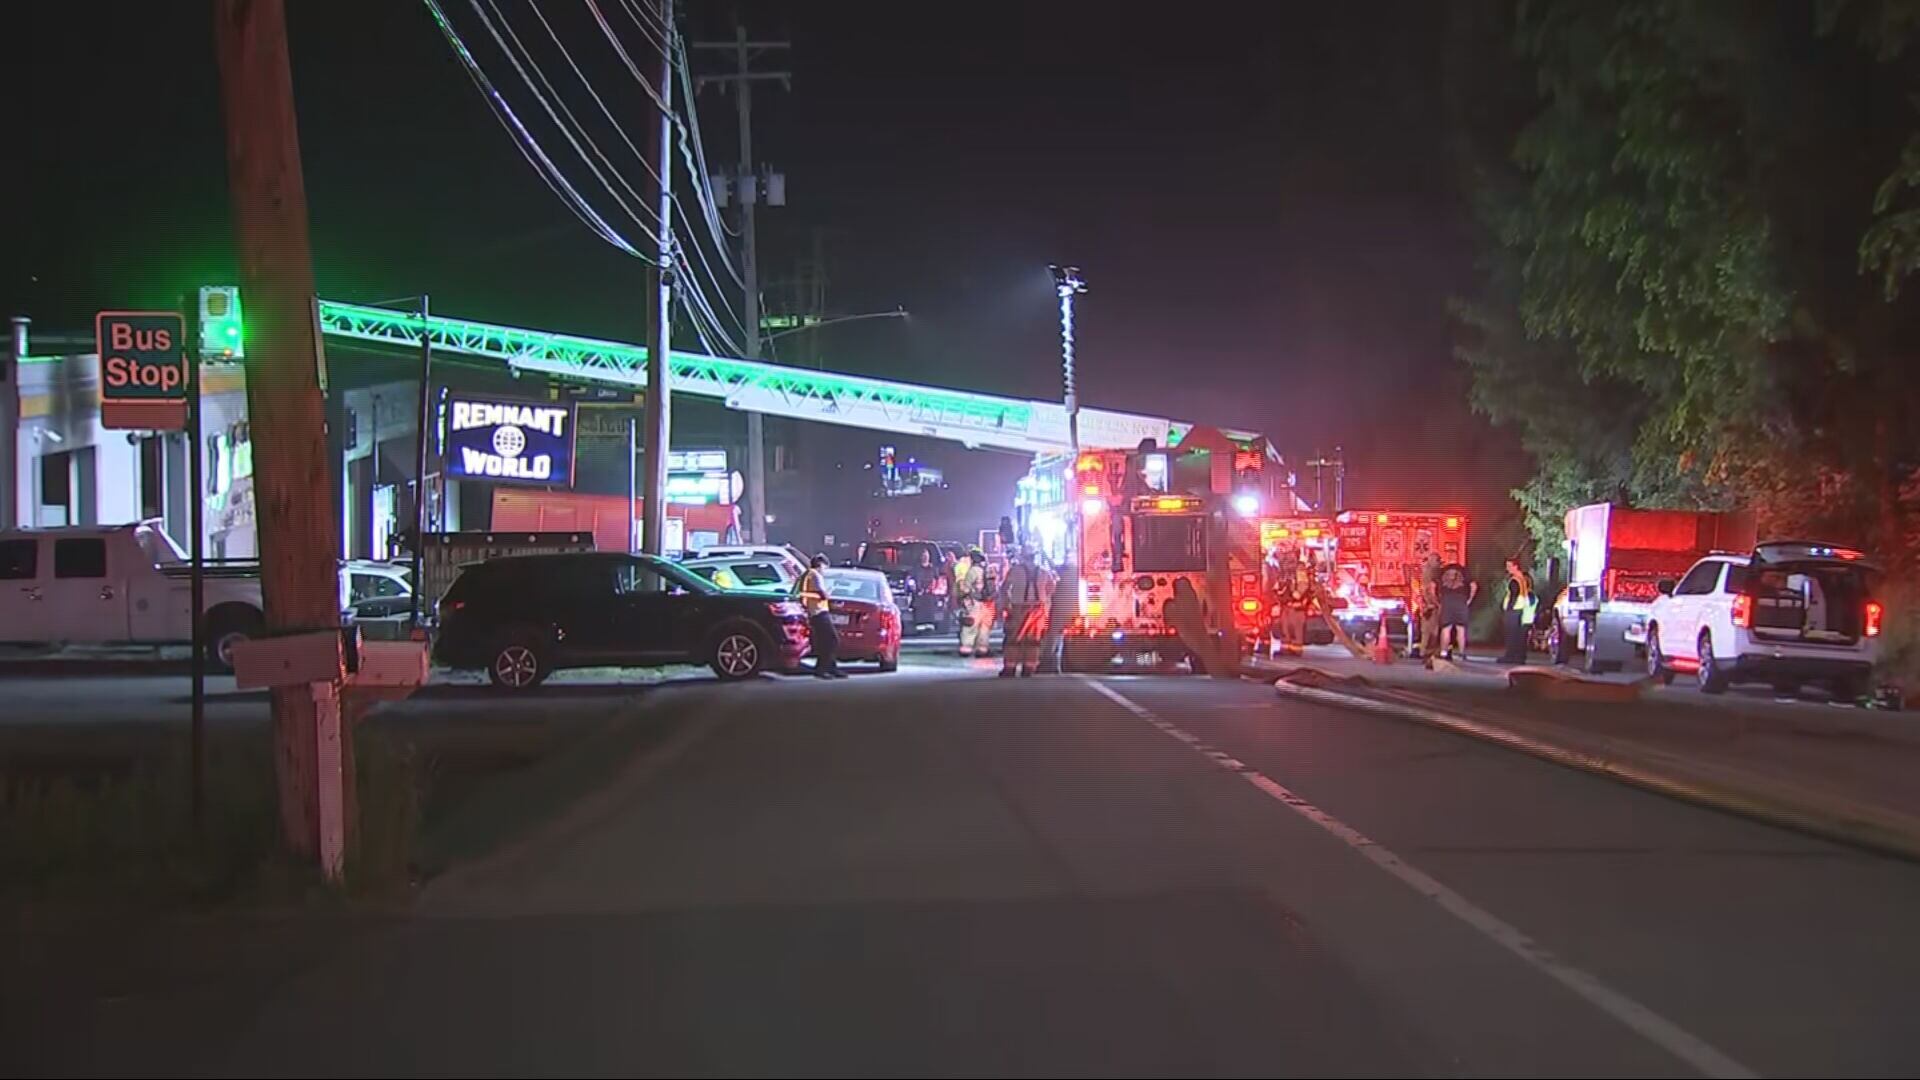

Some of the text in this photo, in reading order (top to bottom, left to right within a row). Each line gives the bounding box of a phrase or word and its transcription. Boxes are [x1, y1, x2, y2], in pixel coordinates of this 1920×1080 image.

[111, 323, 171, 351] Bus
[107, 358, 180, 391] Stop
[453, 401, 567, 437] REMNANT
[462, 447, 551, 479] WORLD
